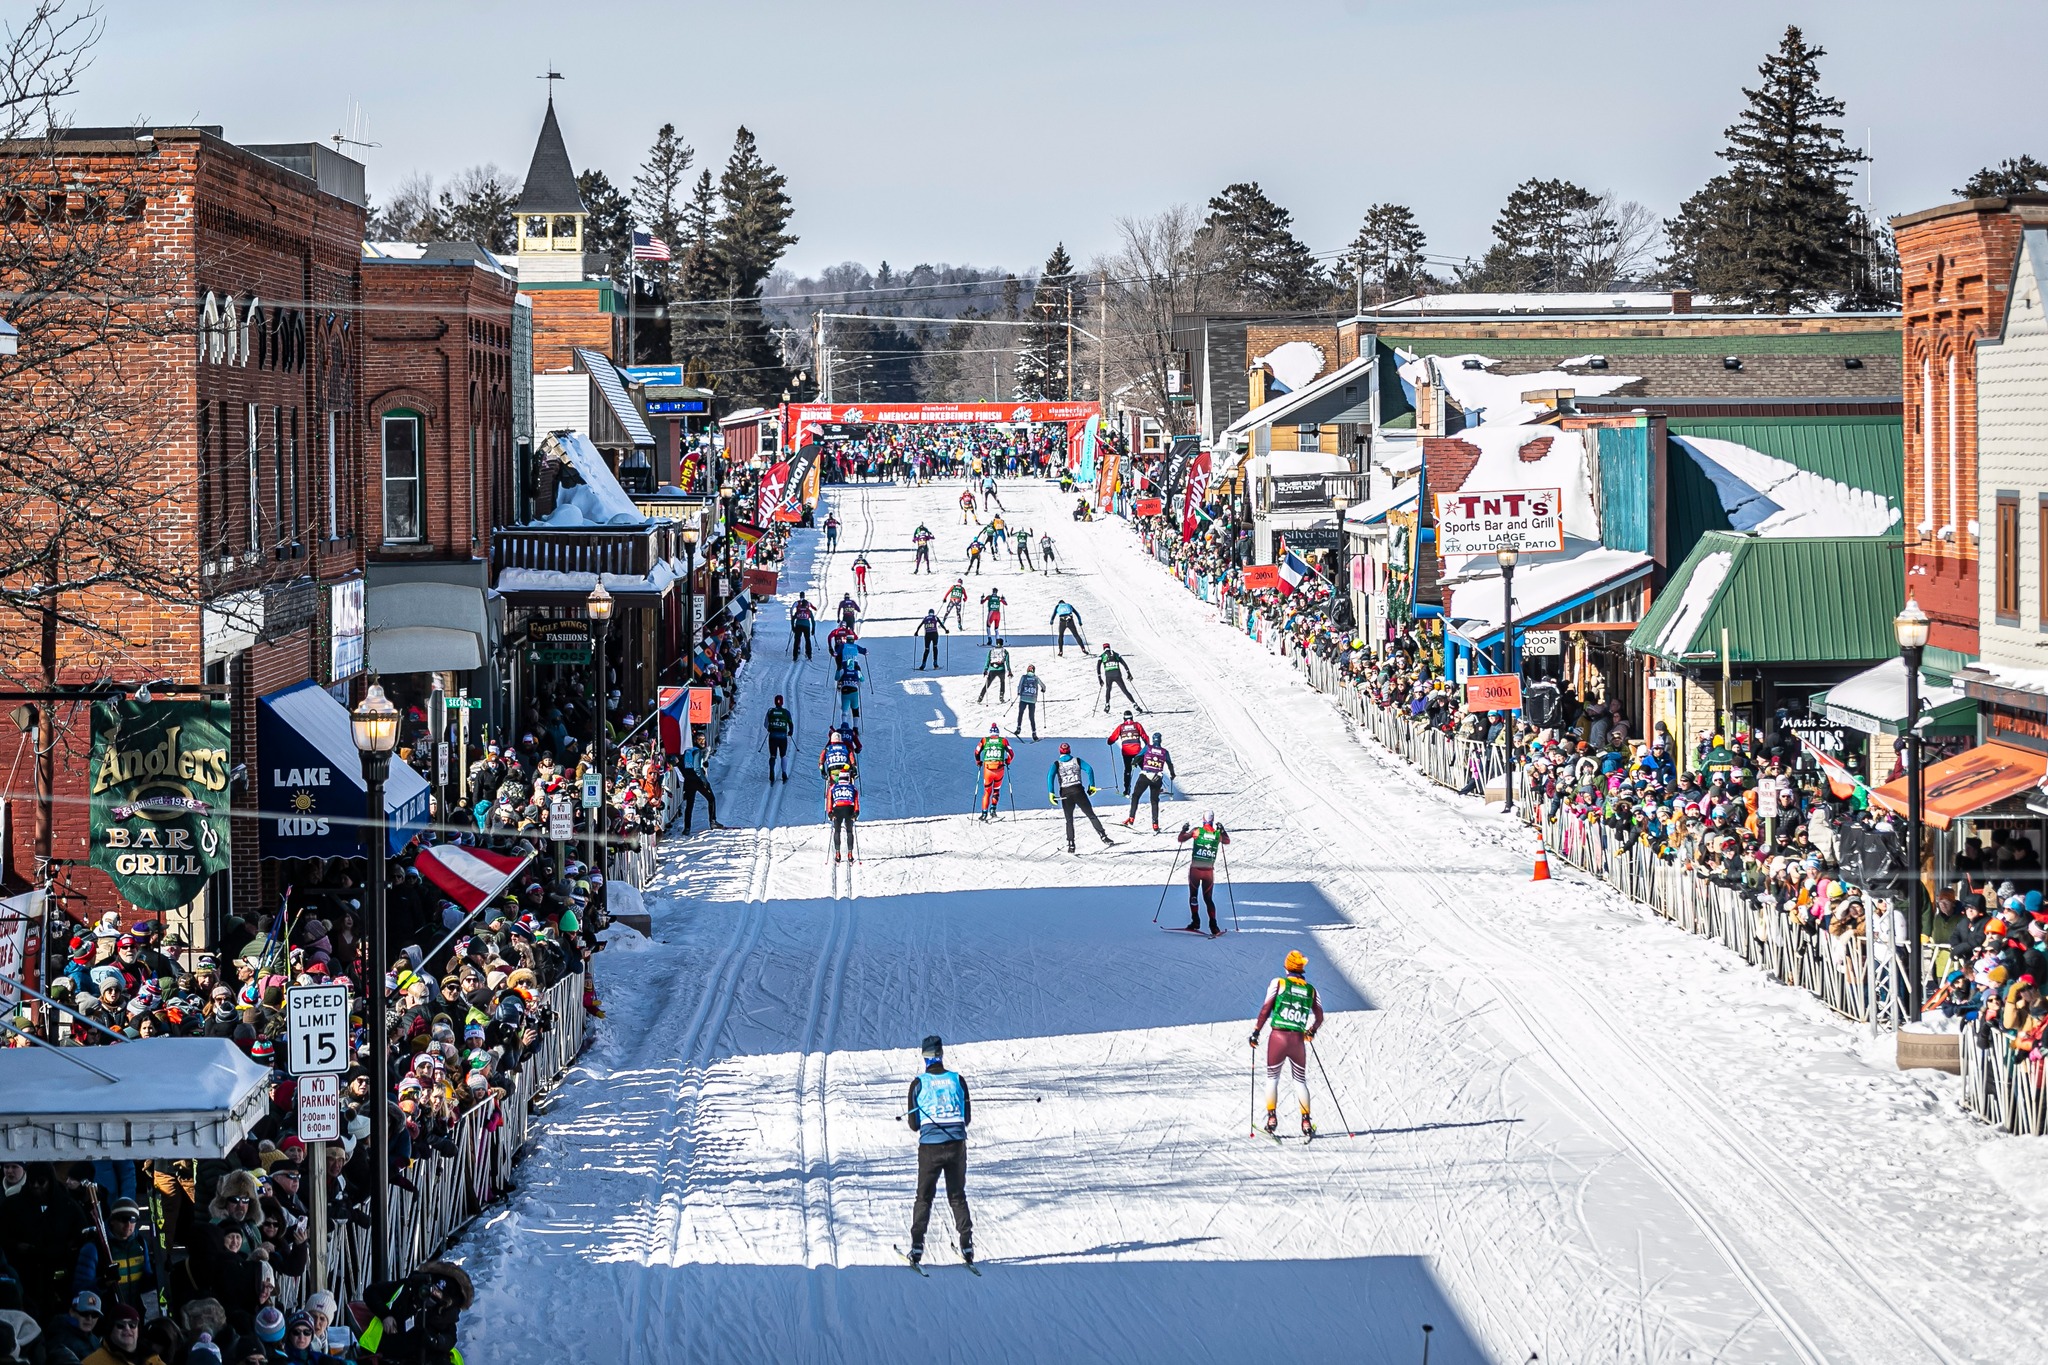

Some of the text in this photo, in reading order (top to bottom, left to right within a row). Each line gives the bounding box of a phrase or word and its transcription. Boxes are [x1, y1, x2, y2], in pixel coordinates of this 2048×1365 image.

[878, 411, 1002, 421] AMERICAN BIRKEBEINER FINISH
[1444, 517, 1554, 535] Sports Bar and Grill
[1284, 530, 1316, 539] Silver
[1525, 540, 1557, 549] PATIO
[1255, 571, 1274, 580] 200M
[1377, 604, 1385, 616] 15
[529, 620, 588, 635] EAGLE WINGS
[546, 633, 588, 641] FASHIONS
[543, 651, 586, 660] crocs
[1484, 686, 1513, 699] 300M
[1780, 715, 1818, 729] Main
[94, 725, 229, 793] Anglers
[274, 768, 331, 787] LAKE
[121, 797, 195, 817] Established 1936
[277, 818, 330, 836] KIDS
[1984, 819, 2033, 829] FUDGE
[106, 819, 218, 857] BAR &
[115, 854, 201, 875] GRILL
[293, 994, 343, 1009] SPEED
[299, 1013, 337, 1028] LIMIT
[1280, 1007, 1307, 1024] 4604
[302, 1032, 337, 1065] 15
[311, 1079, 325, 1092] NO
[301, 1094, 336, 1108] PARKING
[302, 1112, 336, 1122] 2:00am to
[306, 1123, 332, 1132] 6:00am
